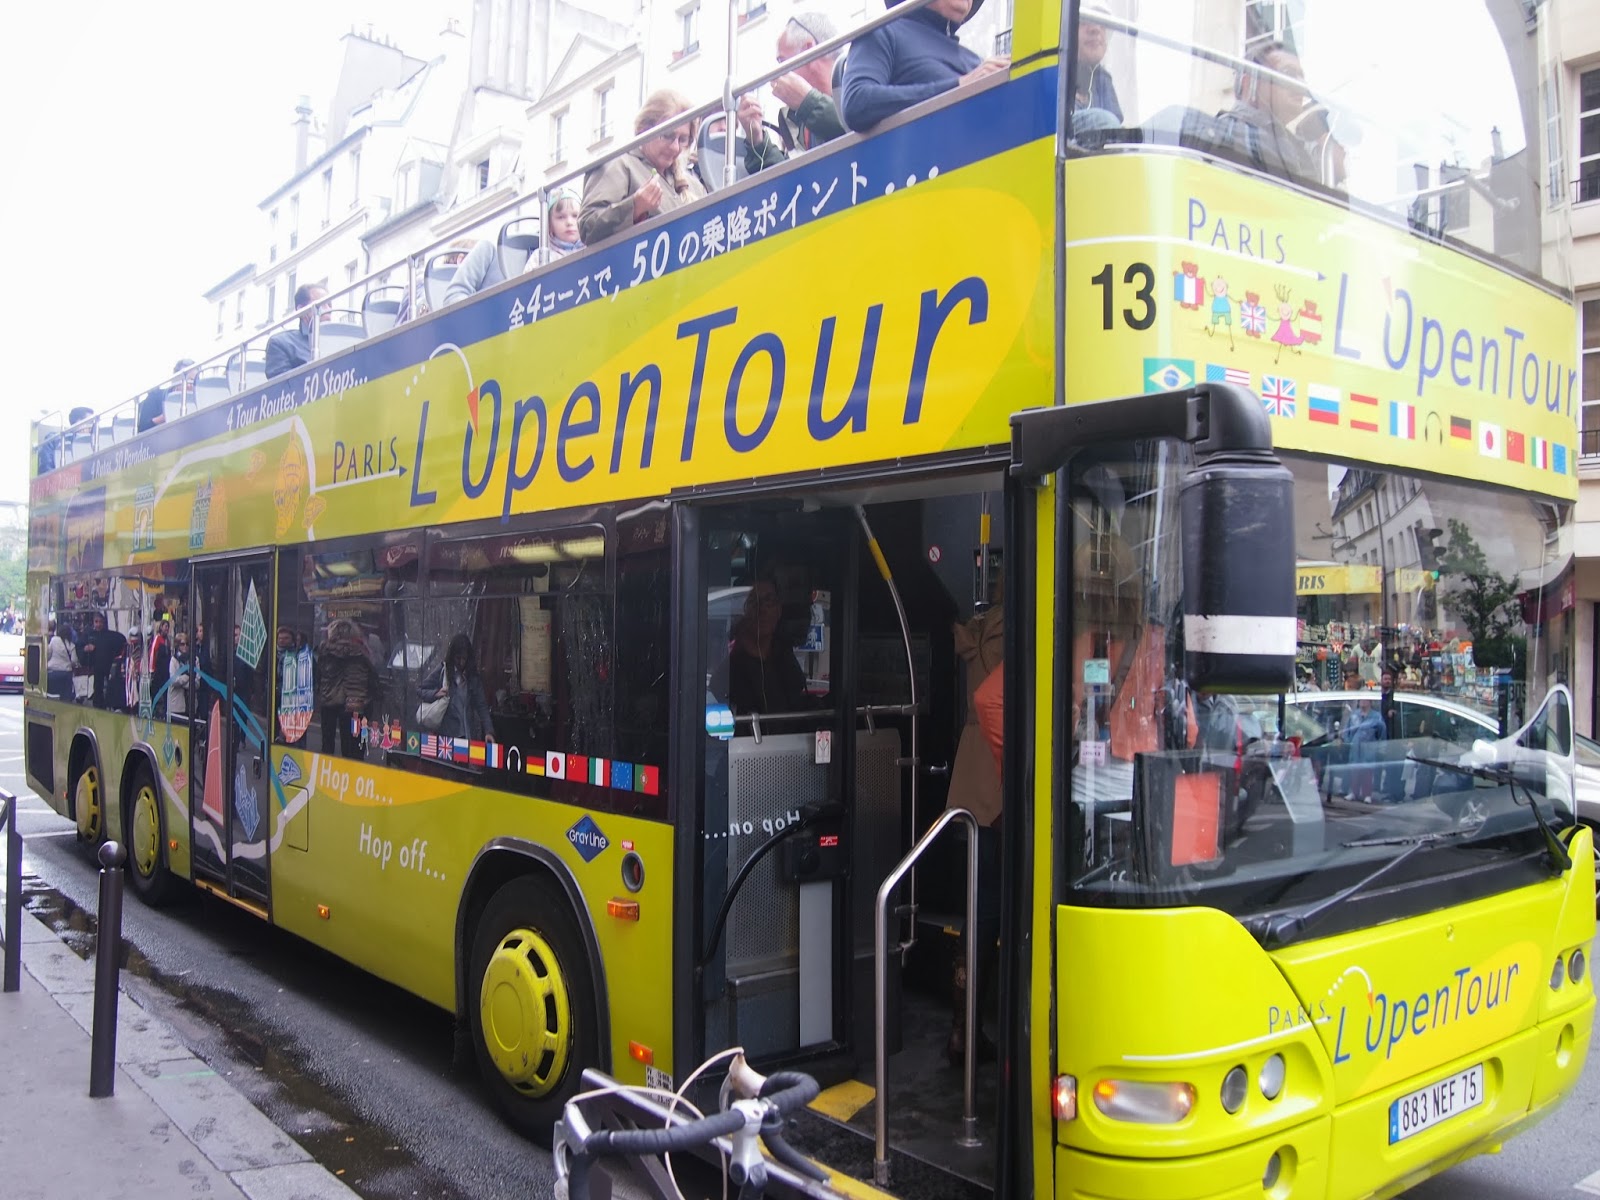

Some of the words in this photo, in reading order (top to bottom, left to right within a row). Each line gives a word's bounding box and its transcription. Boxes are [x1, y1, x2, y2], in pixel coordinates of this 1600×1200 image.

[1189, 198, 1285, 264] PARIS
[1092, 263, 1156, 330] 13
[227, 404, 234, 432] 4
[236, 402, 258, 429] Tour
[259, 390, 298, 421] Routes,
[302, 372, 319, 405] 50
[321, 367, 368, 401] Stops...
[334, 436, 397, 484] PARIS
[320, 759, 349, 801] Hop
[355, 776, 393, 804] on...
[359, 822, 392, 870] Hop
[400, 838, 446, 881] off...
[1269, 1000, 1326, 1034] PARIS
[1403, 1092, 1427, 1131] 883
[1433, 1080, 1456, 1118] NEF
[1462, 1071, 1477, 1104] 75
